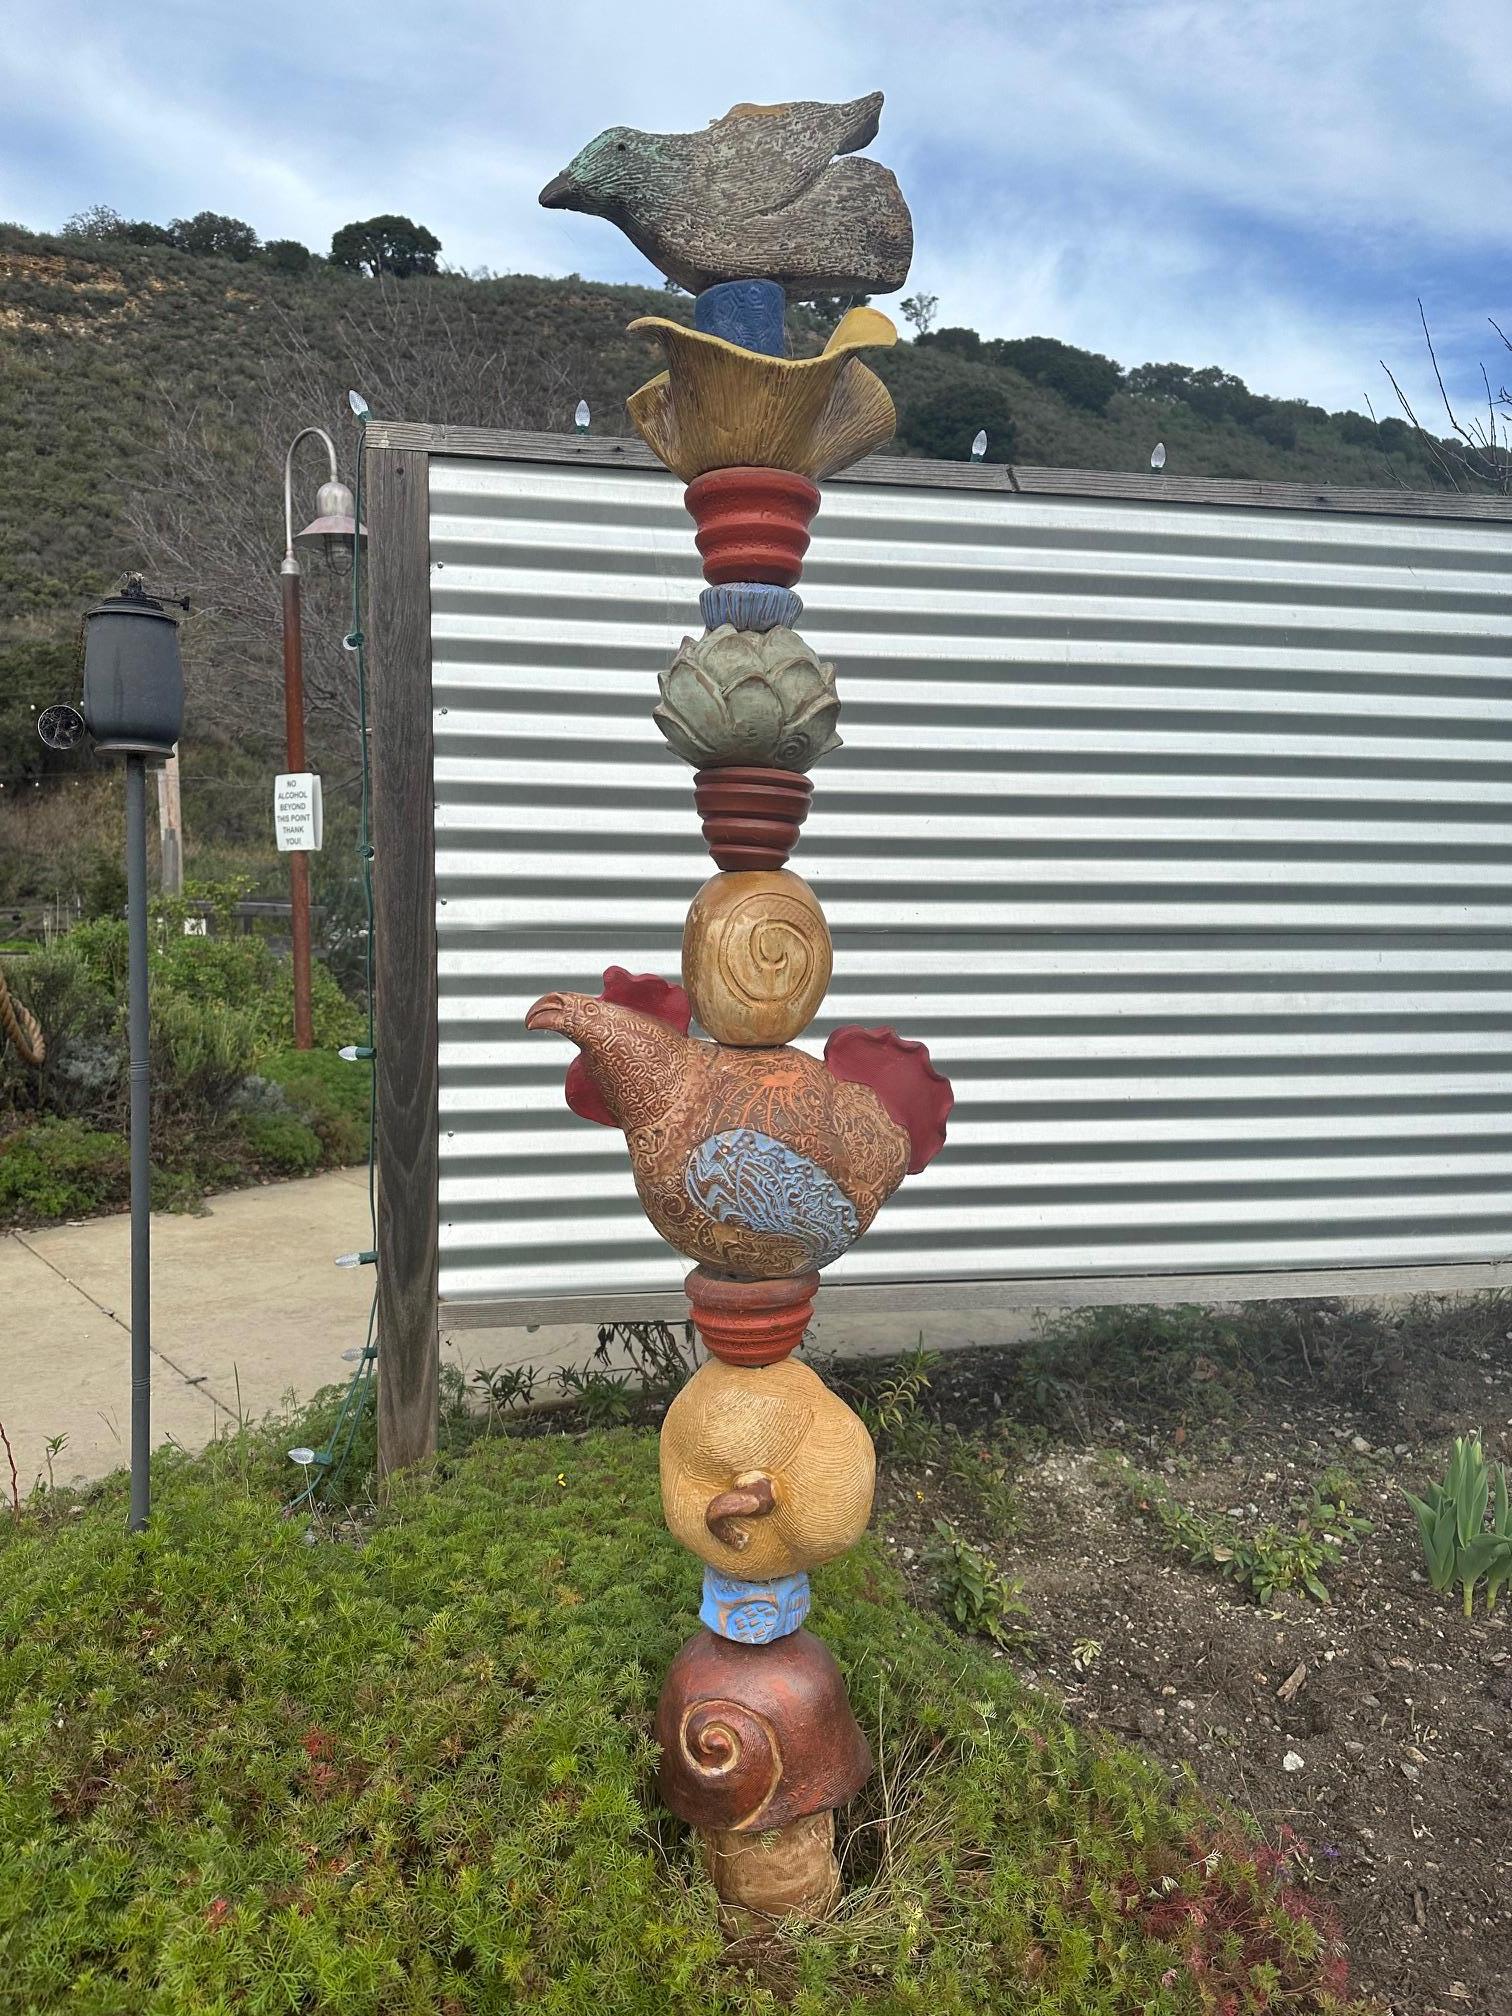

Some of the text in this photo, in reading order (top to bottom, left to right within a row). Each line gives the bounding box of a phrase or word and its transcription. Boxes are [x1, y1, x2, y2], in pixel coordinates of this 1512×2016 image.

[287, 780, 296, 788] NO
[278, 791, 308, 800] ALCOHOL
[280, 803, 306, 811] BEYOND
[277, 814, 310, 823] THIS POINT
